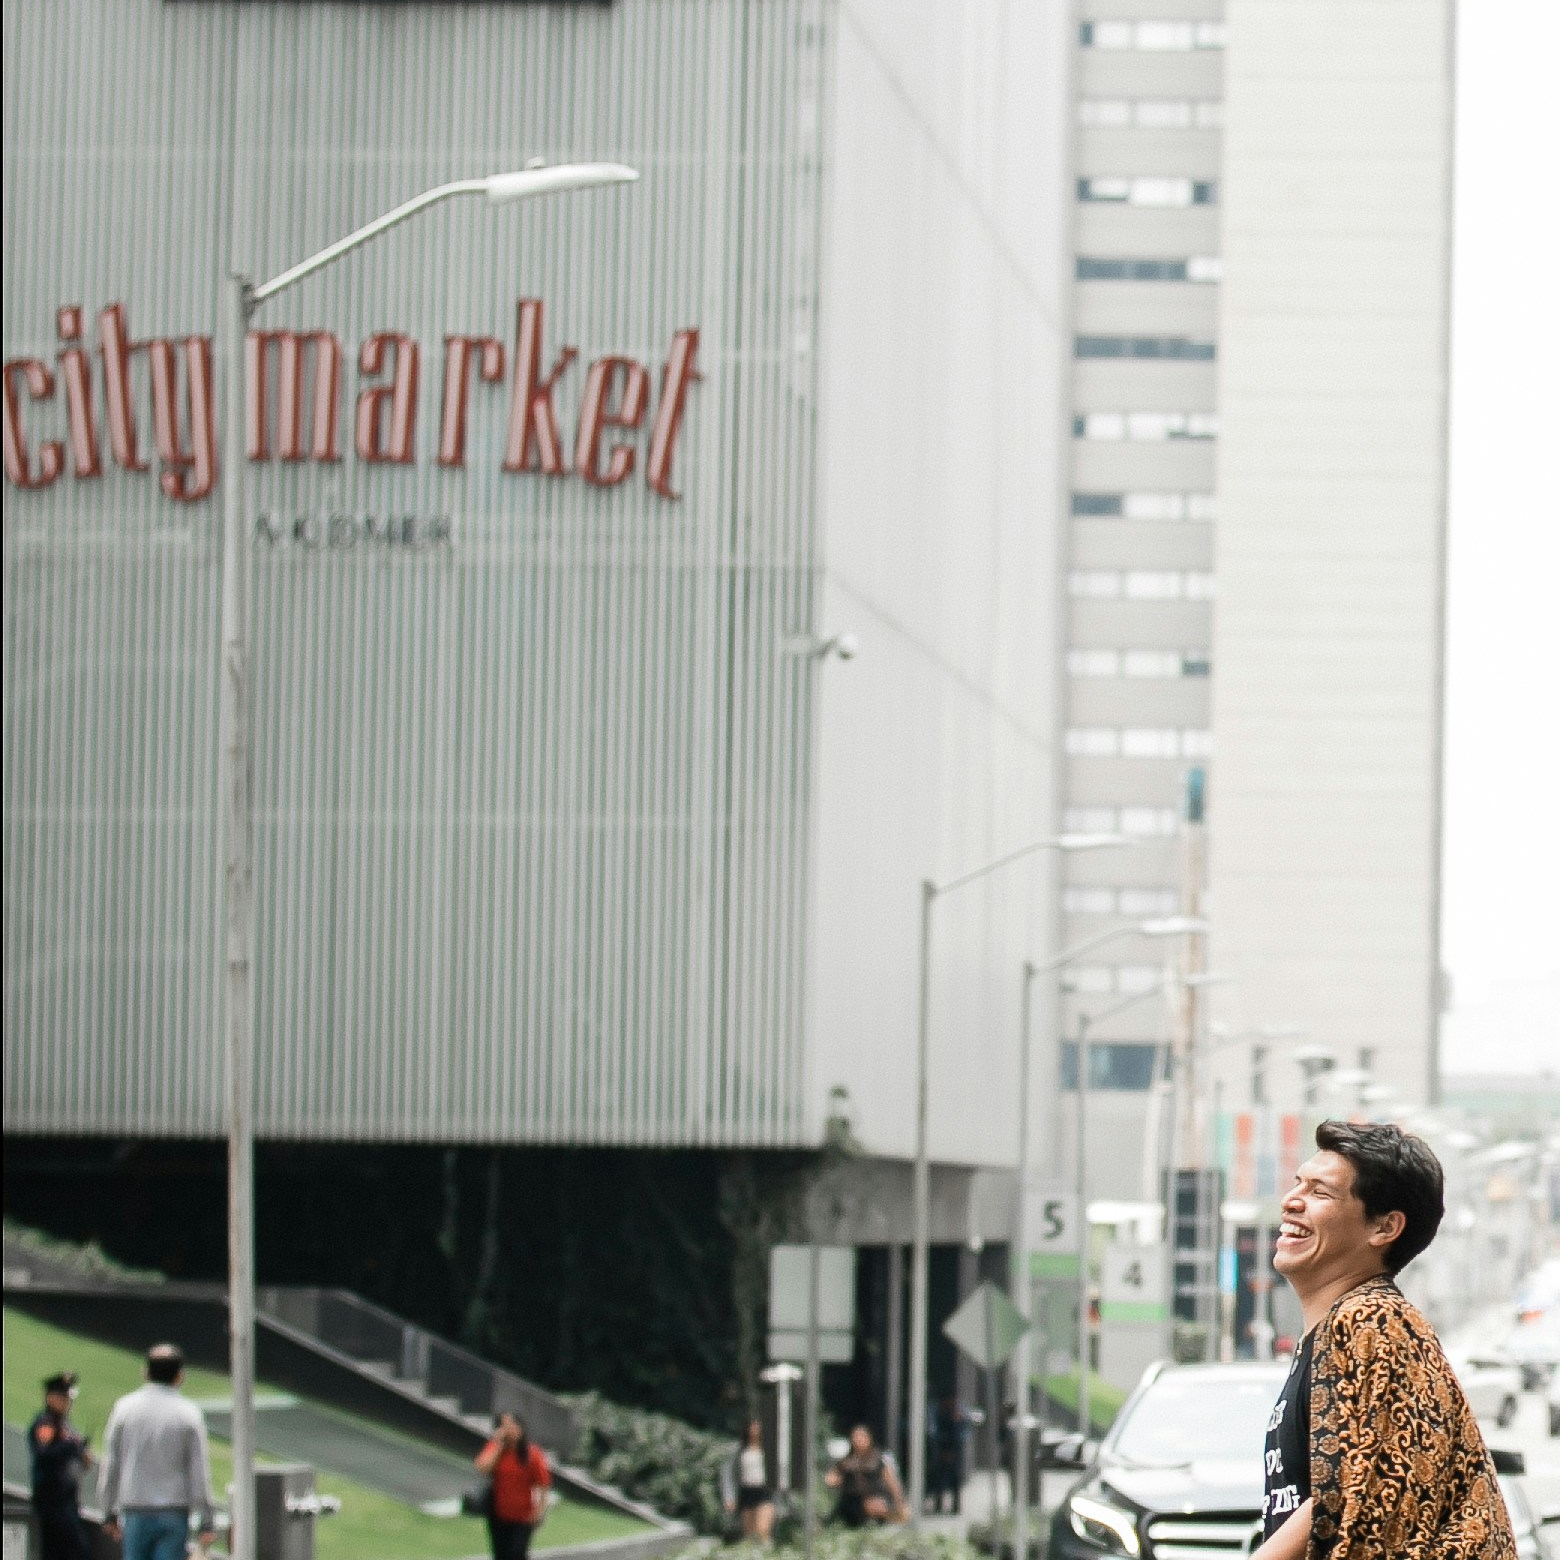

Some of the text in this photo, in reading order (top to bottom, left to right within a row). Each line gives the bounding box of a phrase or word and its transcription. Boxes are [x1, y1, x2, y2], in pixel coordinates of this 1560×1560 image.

[2, 298, 704, 502] city market
[1043, 1200, 1065, 1240] 5
[1122, 1259, 1143, 1287] 4
